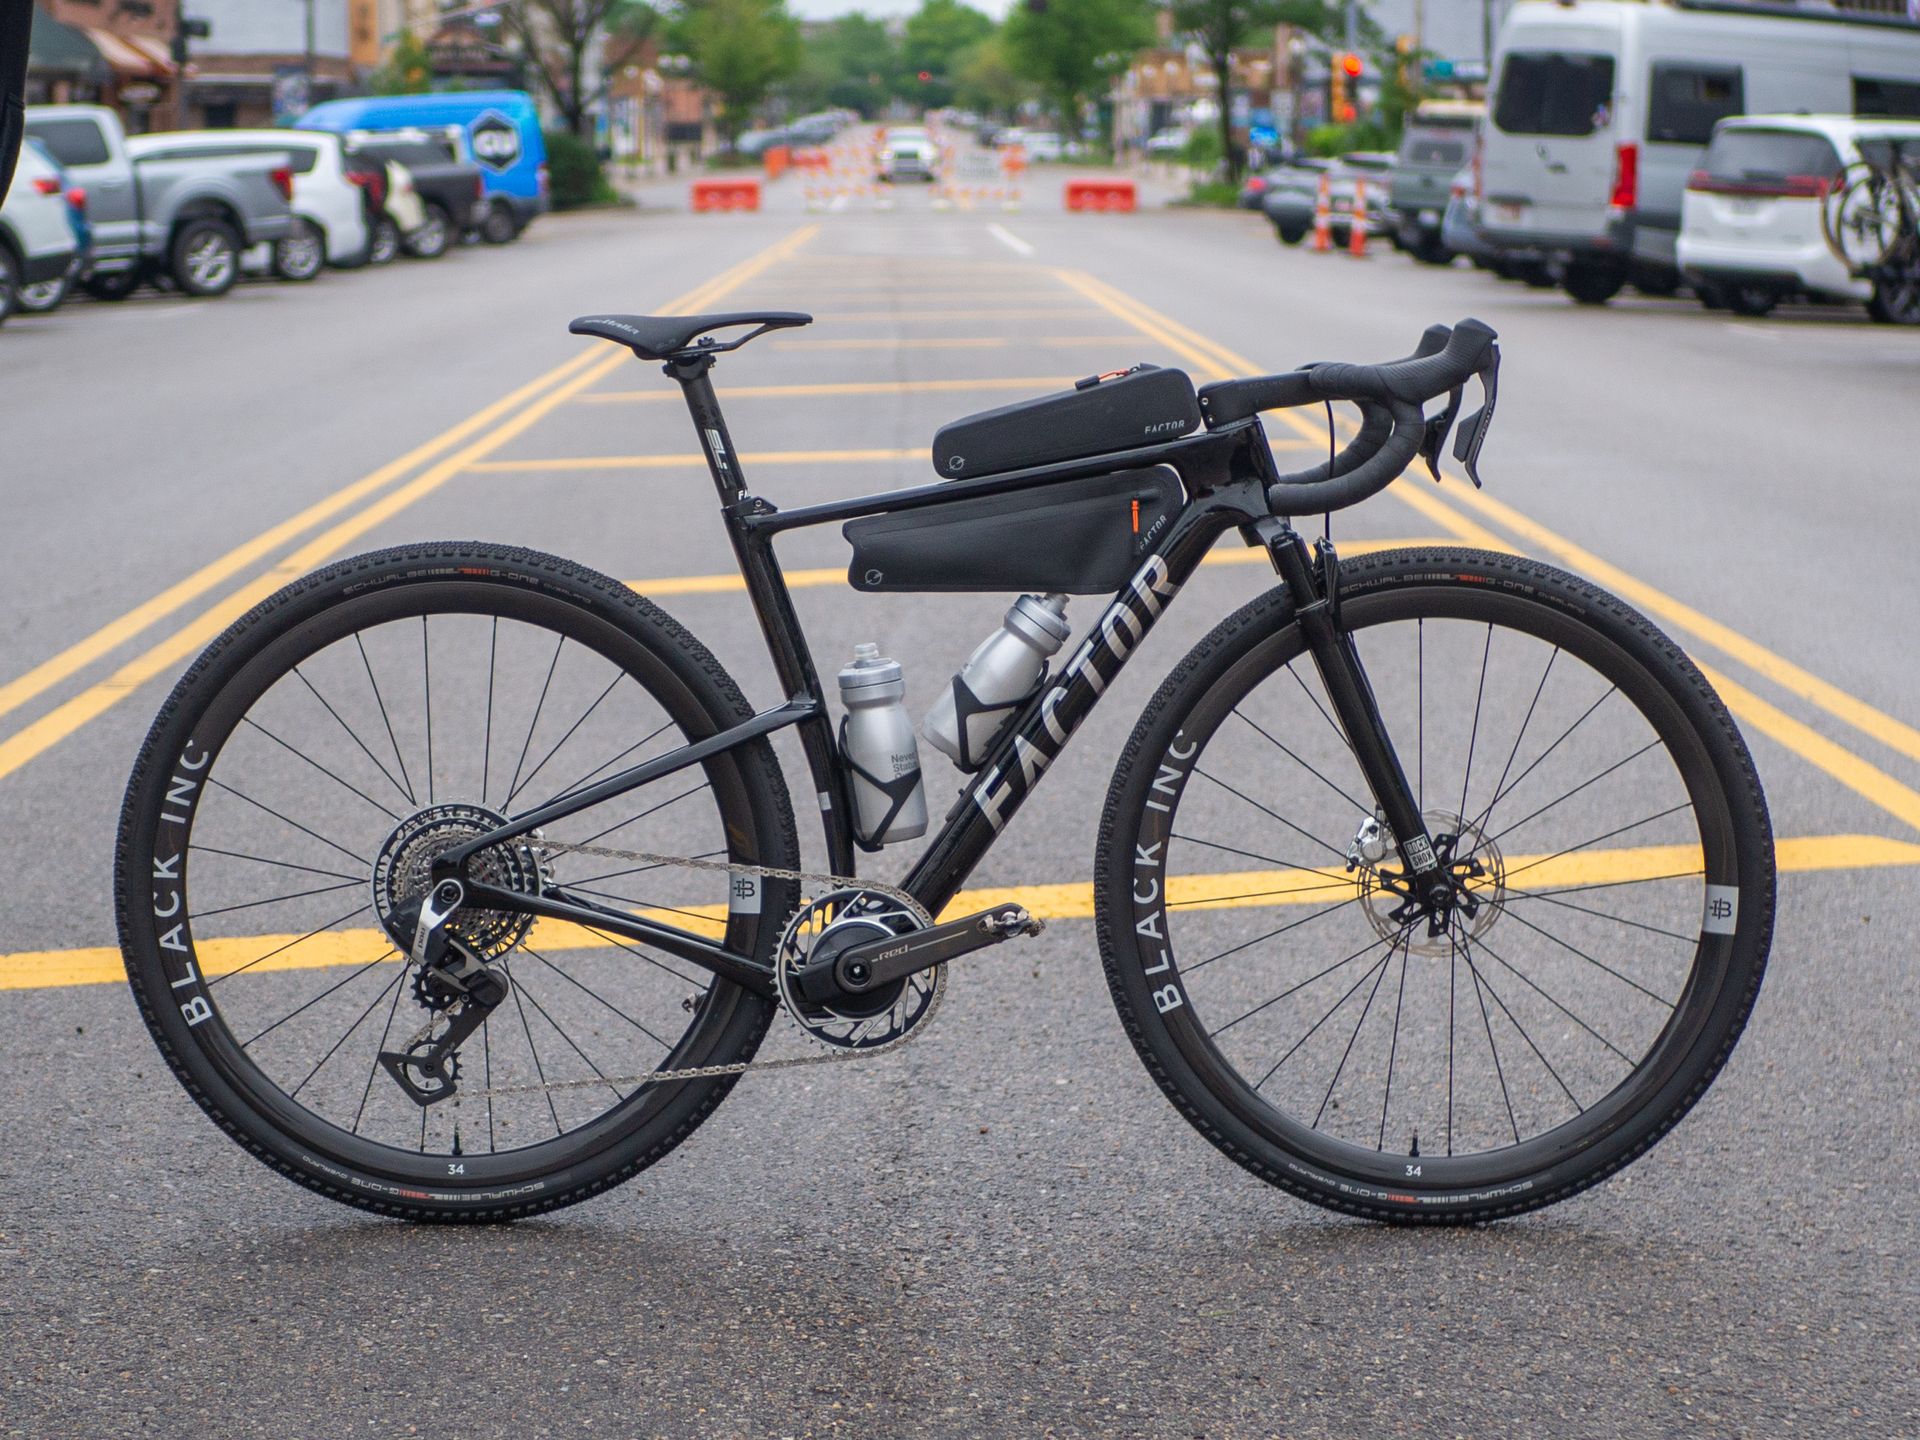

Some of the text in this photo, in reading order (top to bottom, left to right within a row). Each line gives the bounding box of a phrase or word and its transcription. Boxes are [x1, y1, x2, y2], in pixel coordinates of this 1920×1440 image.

[1144, 419, 1185, 434] FACTOR
[1139, 514, 1167, 551] FACTOR
[343, 569, 427, 595] SCHWALBE
[1339, 574, 1424, 595] SCHWALBE
[972, 554, 1181, 834] FACTOR
[1406, 837, 1429, 855] ROCK
[1411, 849, 1434, 867] SHOX
[1133, 729, 1198, 1014] BLACK INC
[152, 739, 213, 1027] BLACK INC
[448, 1163, 465, 1176] 34
[1405, 1164, 1422, 1177] 34
[463, 1181, 545, 1202] SCHWALBE
[1451, 1180, 1533, 1203] SCHWALBE
